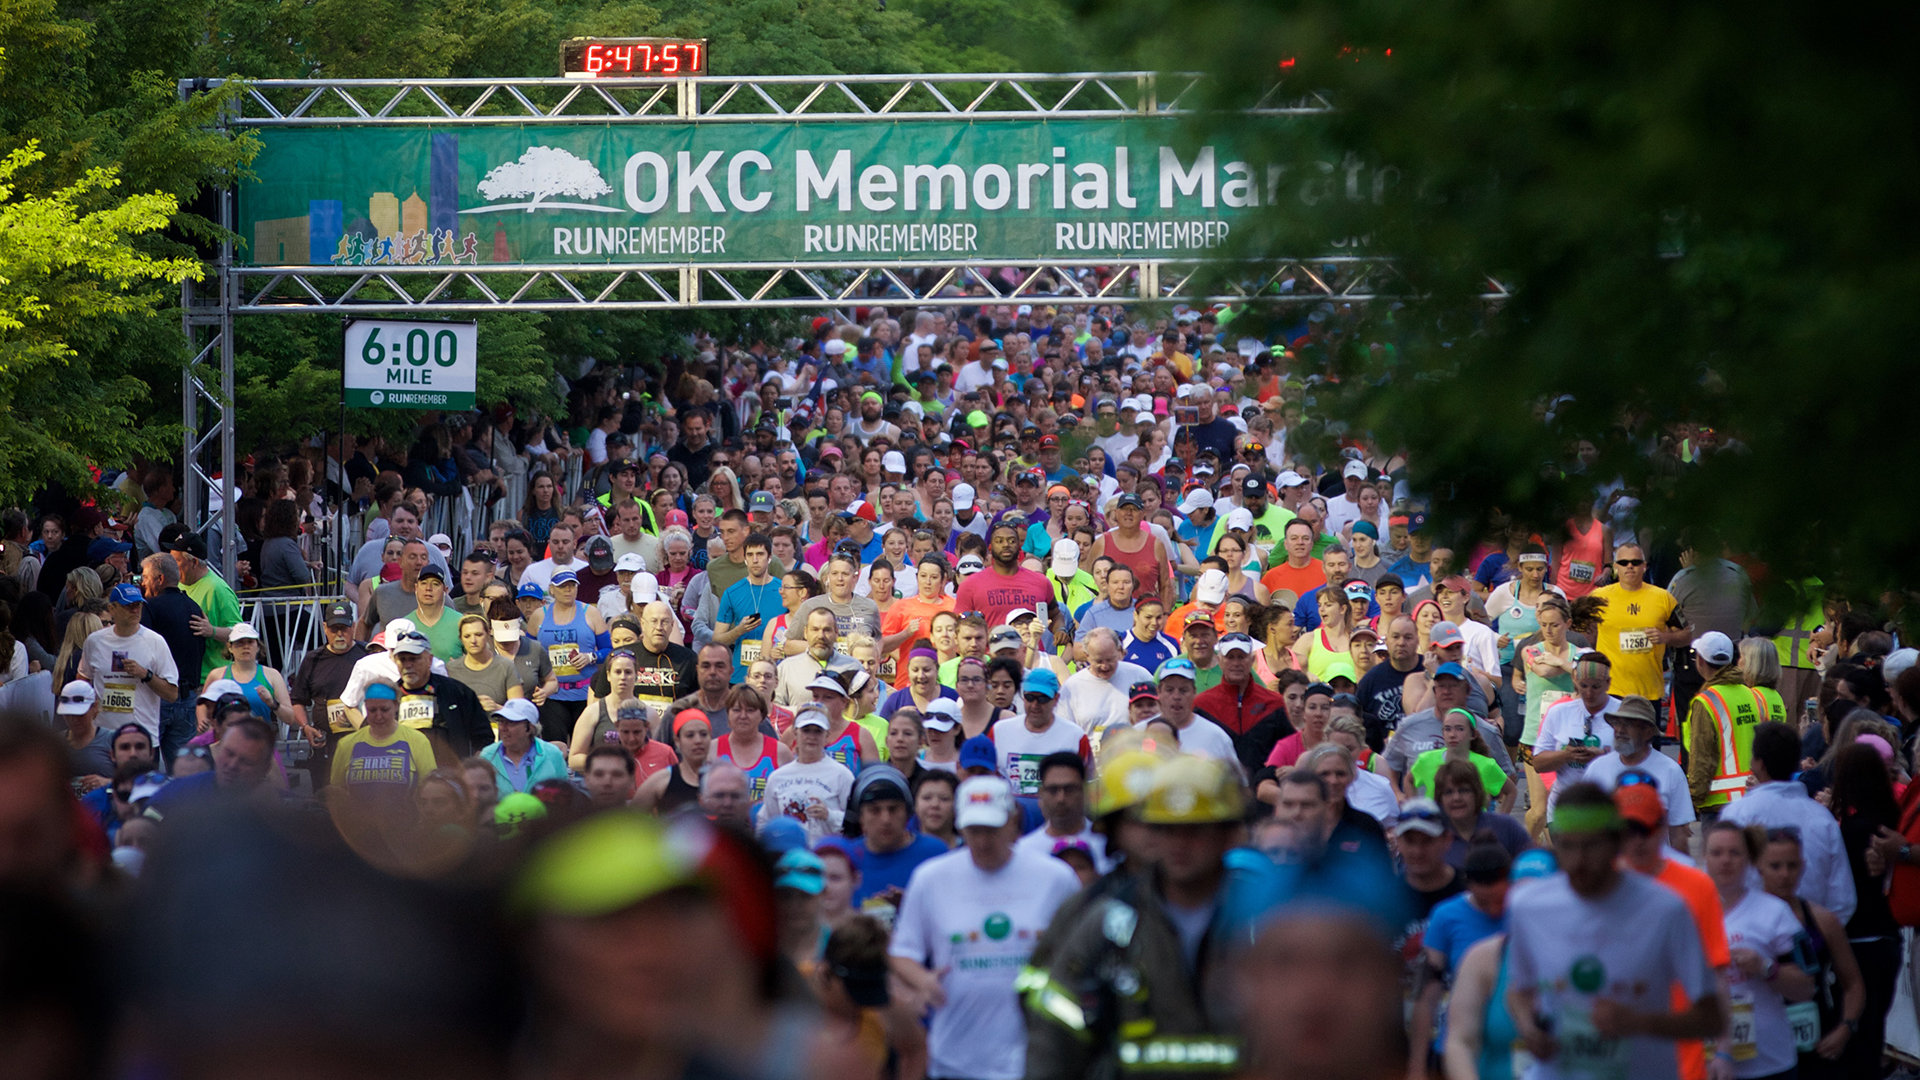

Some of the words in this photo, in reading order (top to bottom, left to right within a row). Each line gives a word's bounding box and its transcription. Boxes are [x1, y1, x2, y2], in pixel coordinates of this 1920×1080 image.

[624, 149, 773, 214] OKC
[796, 146, 1137, 212] Memorial
[362, 327, 457, 367] 6:00
[387, 368, 432, 385] MILE
[988, 594, 1036, 606] OUTLAWS
[106, 694, 132, 707] 16085
[403, 706, 430, 720] 10244
[1737, 704, 1752, 714] RACE
